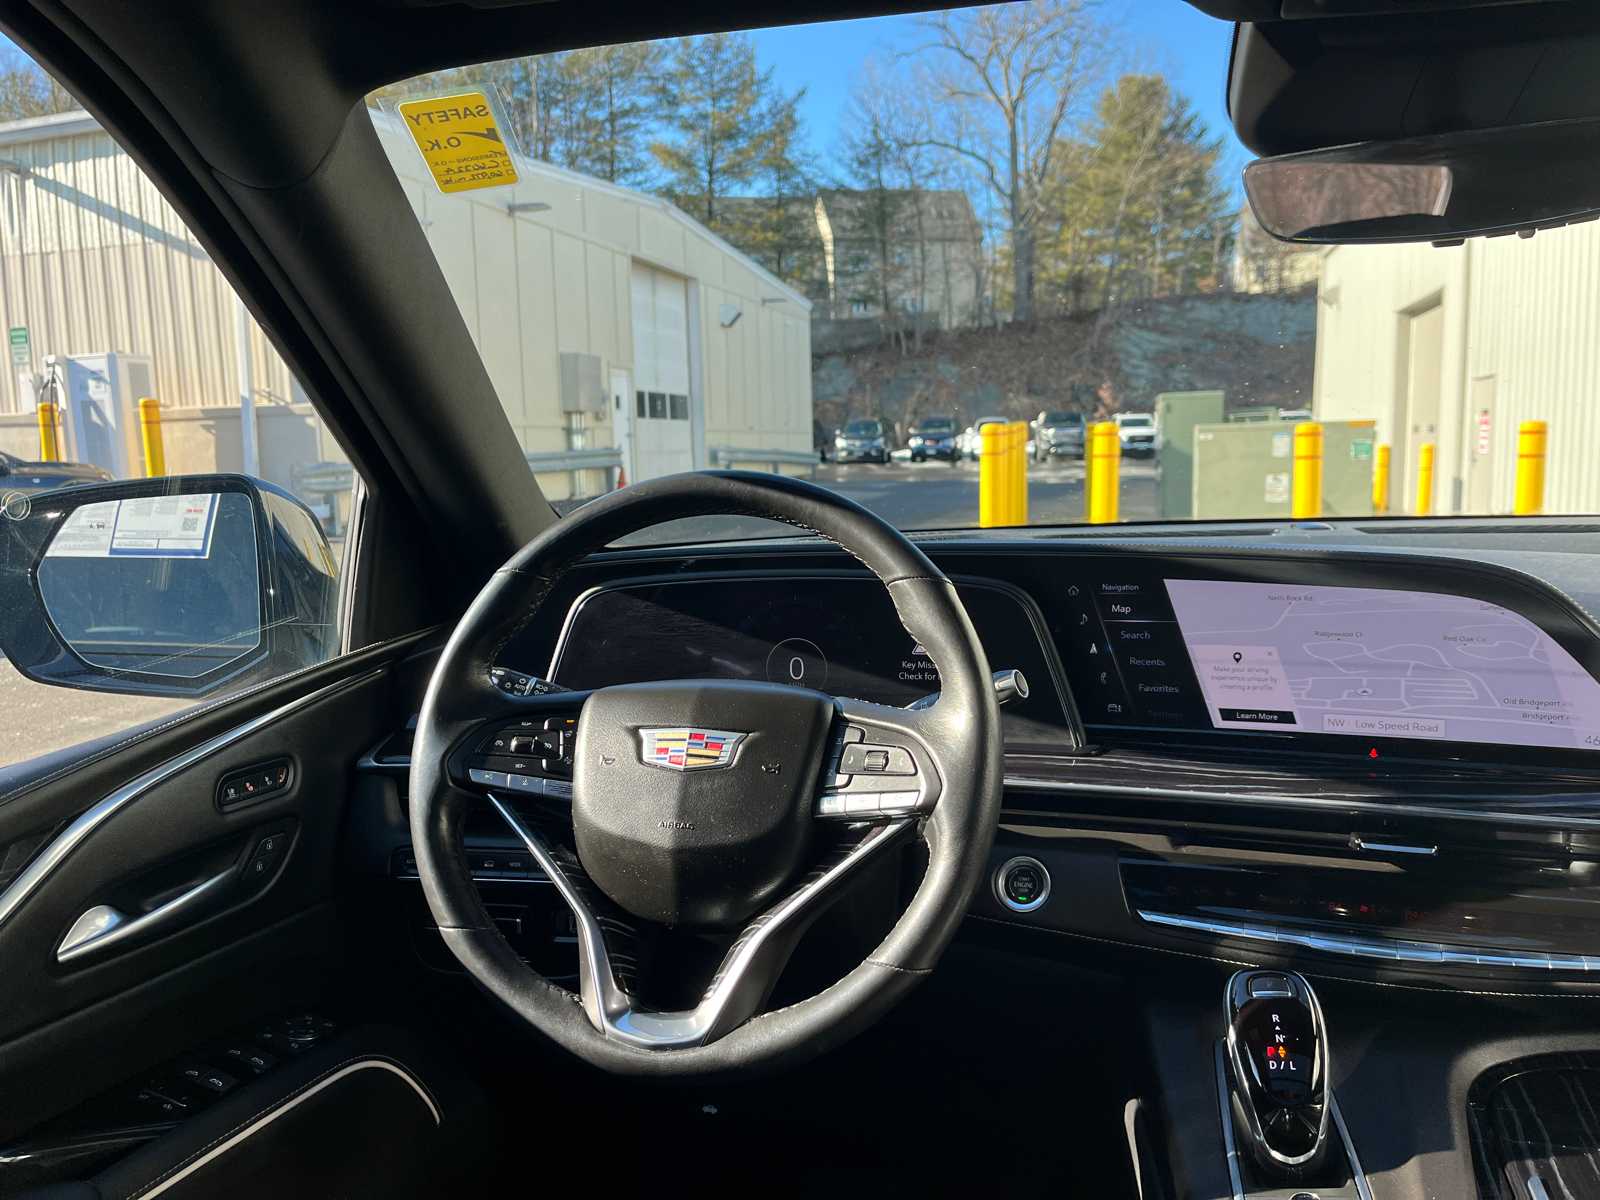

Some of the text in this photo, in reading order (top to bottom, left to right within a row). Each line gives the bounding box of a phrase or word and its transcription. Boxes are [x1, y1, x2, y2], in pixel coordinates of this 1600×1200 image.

[1102, 584, 1139, 592] Navigation
[1111, 605, 1131, 614] Map
[1120, 631, 1150, 639] Search
[901, 661, 935, 670] Key Miss
[1129, 657, 1165, 666] Recents
[789, 657, 804, 680] 0
[898, 672, 922, 680] Check
[924, 672, 936, 680] for
[1138, 684, 1179, 693] Favorites
[1518, 699, 1561, 707] Bridgeport
[1148, 710, 1184, 721] Settings
[1522, 713, 1564, 721] Bridgeport
[1327, 718, 1439, 732] NW Low Speed Road
[657, 821, 695, 830] AIRBAG
[1271, 1014, 1280, 1022] R
[1275, 1034, 1284, 1043] N
[1267, 1046, 1276, 1056] P
